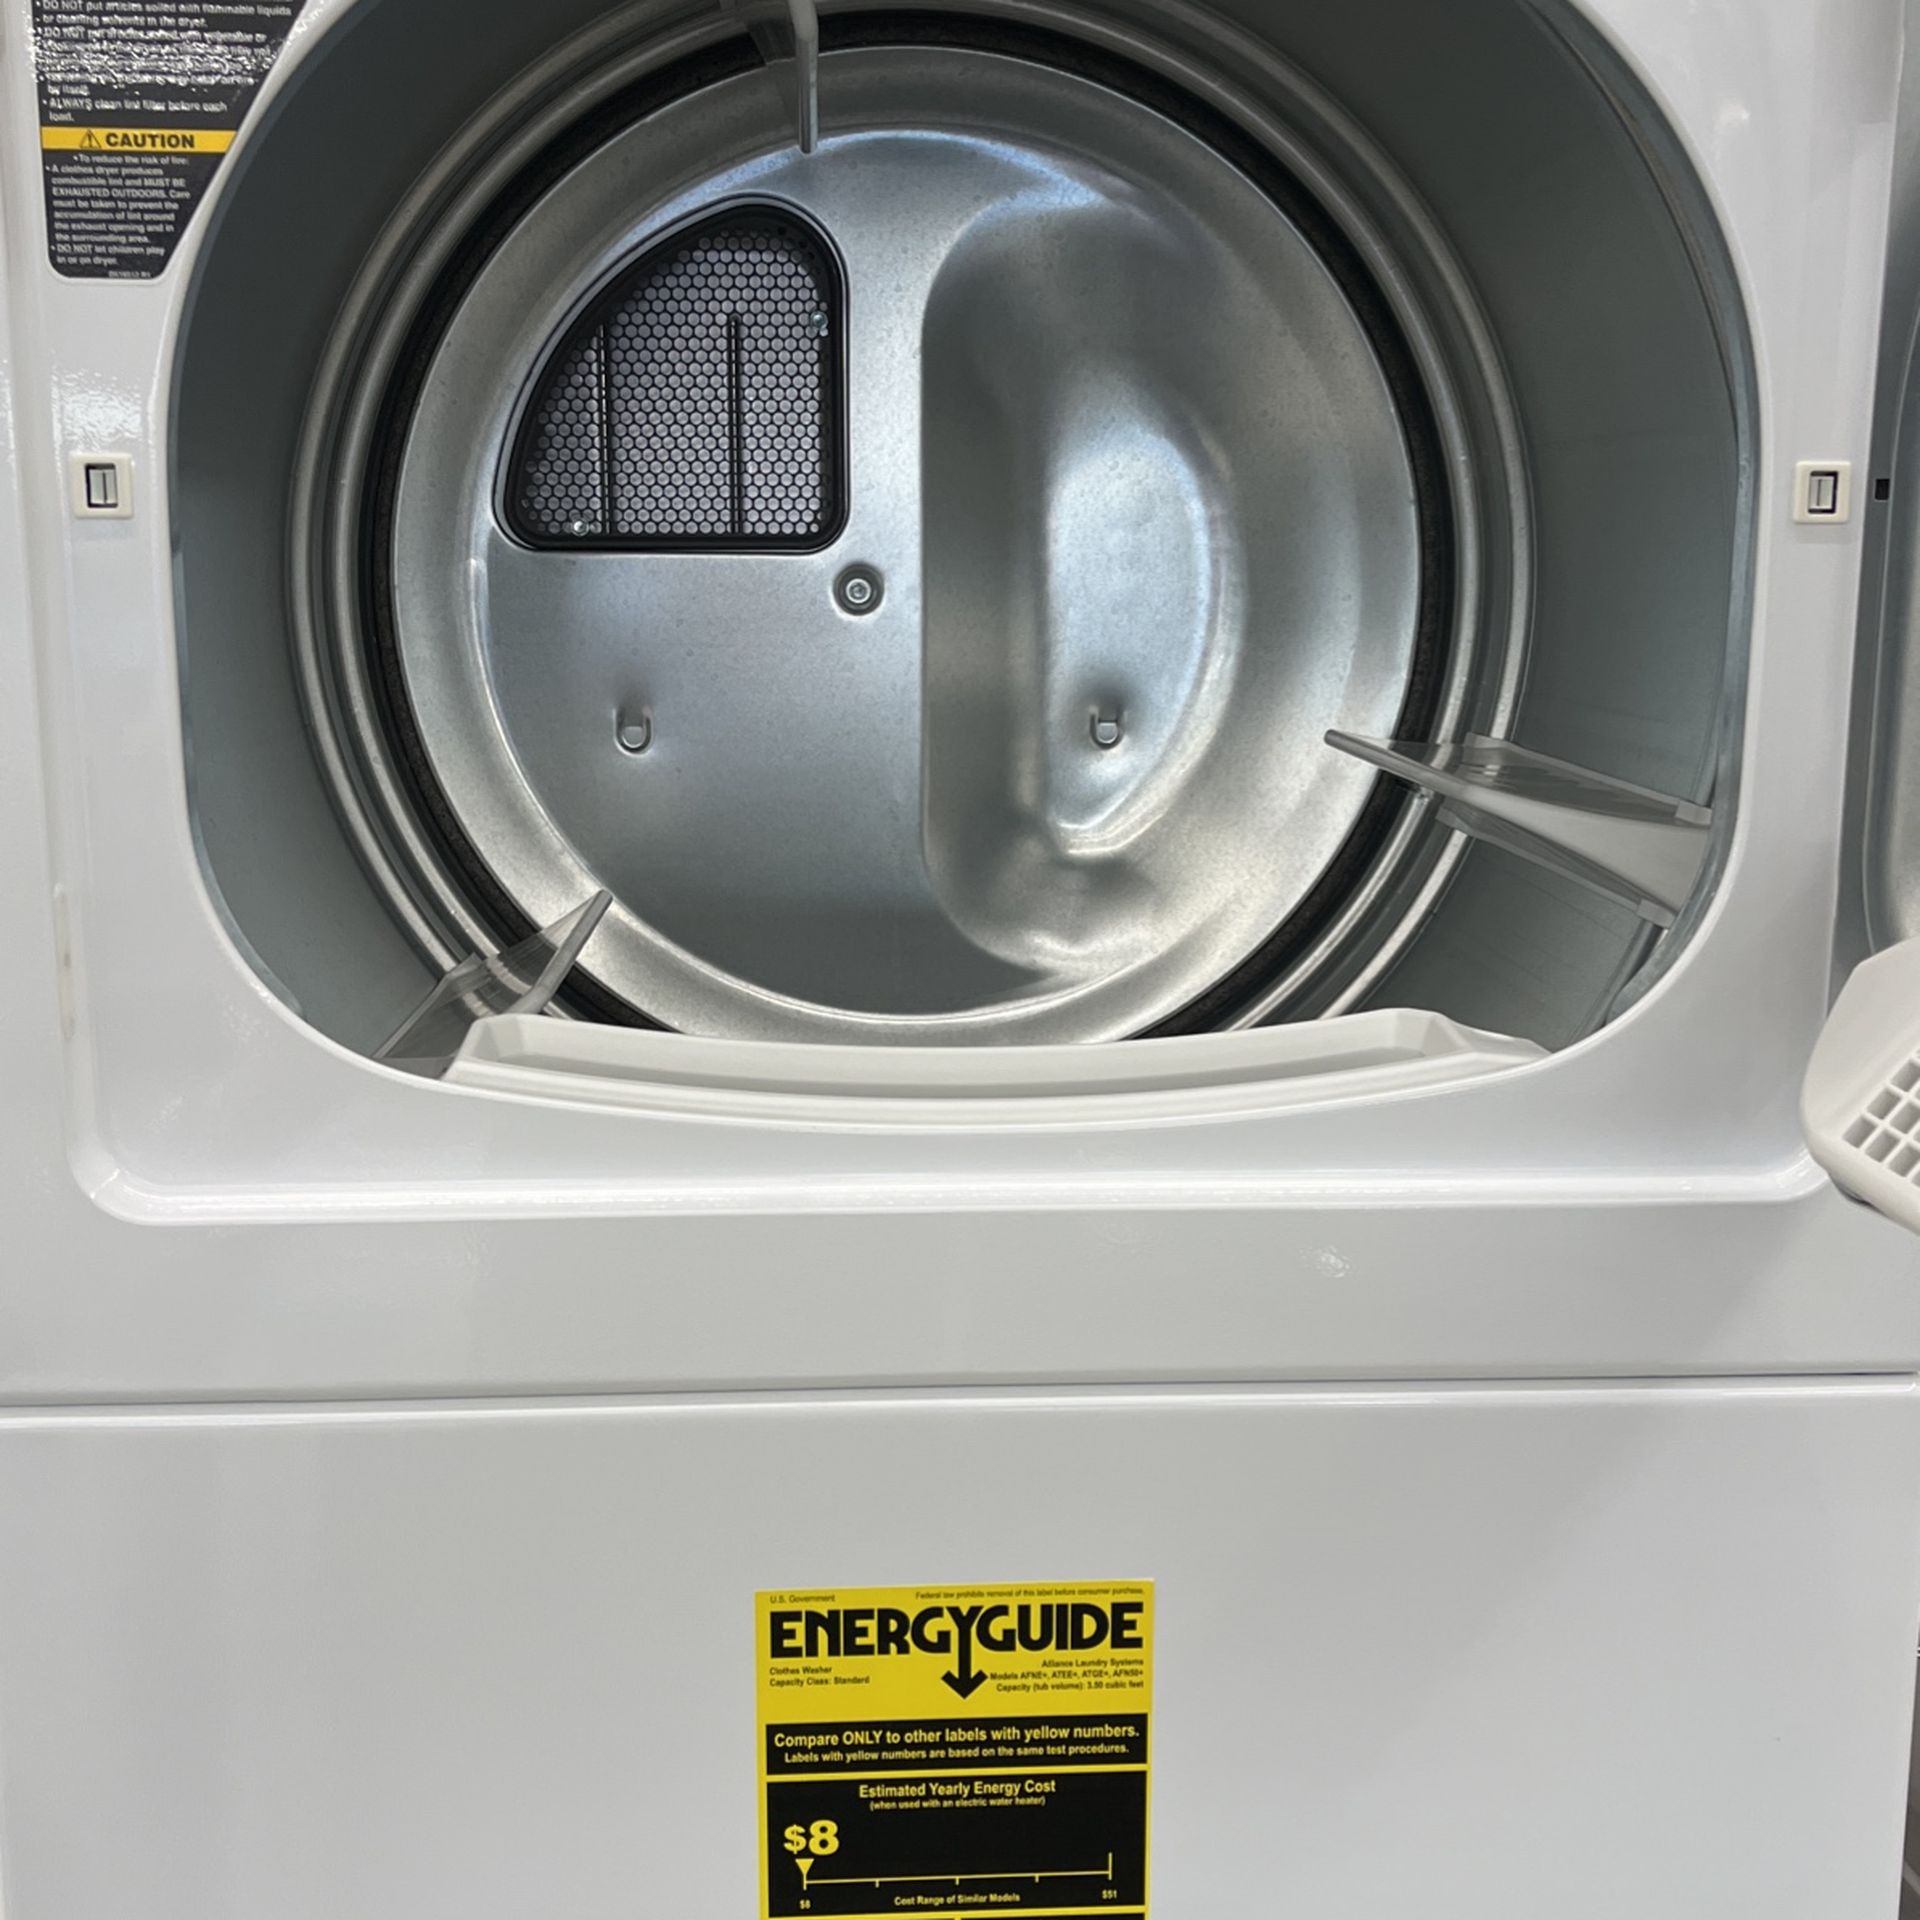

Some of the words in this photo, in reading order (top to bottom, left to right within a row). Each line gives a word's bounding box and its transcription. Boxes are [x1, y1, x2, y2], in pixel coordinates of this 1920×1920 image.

[43, 0, 59, 9] DO
[105, 133, 195, 148] CAUTION
[770, 1595, 786, 1604] U.S.
[789, 1593, 835, 1603] Government
[770, 1602, 1144, 1659] ENERGYGUIDE
[769, 1666, 800, 1675] Clothes
[802, 1665, 832, 1675] Washer
[1041, 1659, 1073, 1668] Alliance
[1075, 1658, 1107, 1668] Laundry
[1110, 1657, 1144, 1668] Systems
[769, 1677, 804, 1688] Capacity
[806, 1677, 831, 1686] Class:
[834, 1675, 870, 1686] Standard
[990, 1671, 1018, 1681] Models
[996, 1682, 1031, 1694] Capacity
[1033, 1681, 1049, 1692] (tub
[1051, 1680, 1084, 1691] volume):
[1087, 1680, 1103, 1690] 3.50
[1105, 1679, 1127, 1689] cubic
[1128, 1678, 1144, 1688] feet
[774, 1733, 839, 1749] Compare
[842, 1730, 883, 1745] ONLY
[886, 1729, 900, 1744] to
[904, 1728, 942, 1743] other
[945, 1727, 987, 1742] labels
[991, 1726, 1020, 1741] with
[1024, 1725, 1070, 1743] yellow
[1073, 1724, 1140, 1739] numbers.
[784, 1752, 819, 1764] Labels
[821, 1751, 843, 1762] with
[845, 1750, 879, 1764] yellow
[881, 1748, 927, 1760] numbers
[929, 1749, 946, 1759] are
[948, 1747, 979, 1758] based
[981, 1748, 995, 1757] on
[997, 1745, 1014, 1757] the
[1016, 1746, 1044, 1756] same
[1046, 1744, 1066, 1755] test
[1068, 1743, 1130, 1757] procedures.
[859, 1783, 926, 1799] Estimated
[929, 1781, 970, 1798] Yearly
[974, 1780, 1021, 1797] Energy
[1024, 1779, 1056, 1793] Cost
[869, 1801, 896, 1812] (when
[898, 1800, 920, 1810] used
[922, 1799, 940, 1809] with
[942, 1800, 953, 1808] an
[955, 1798, 987, 1808] electric
[989, 1797, 1012, 1807] water
[1015, 1796, 1046, 1807] heater)
[783, 1819, 840, 1856] $8
[894, 1895, 915, 1907] Cost
[917, 1895, 944, 1907] Range
[946, 1894, 956, 1905] of
[957, 1893, 988, 1904] Similar
[989, 1892, 1021, 1903] Models
[1102, 1889, 1118, 1900] $51
